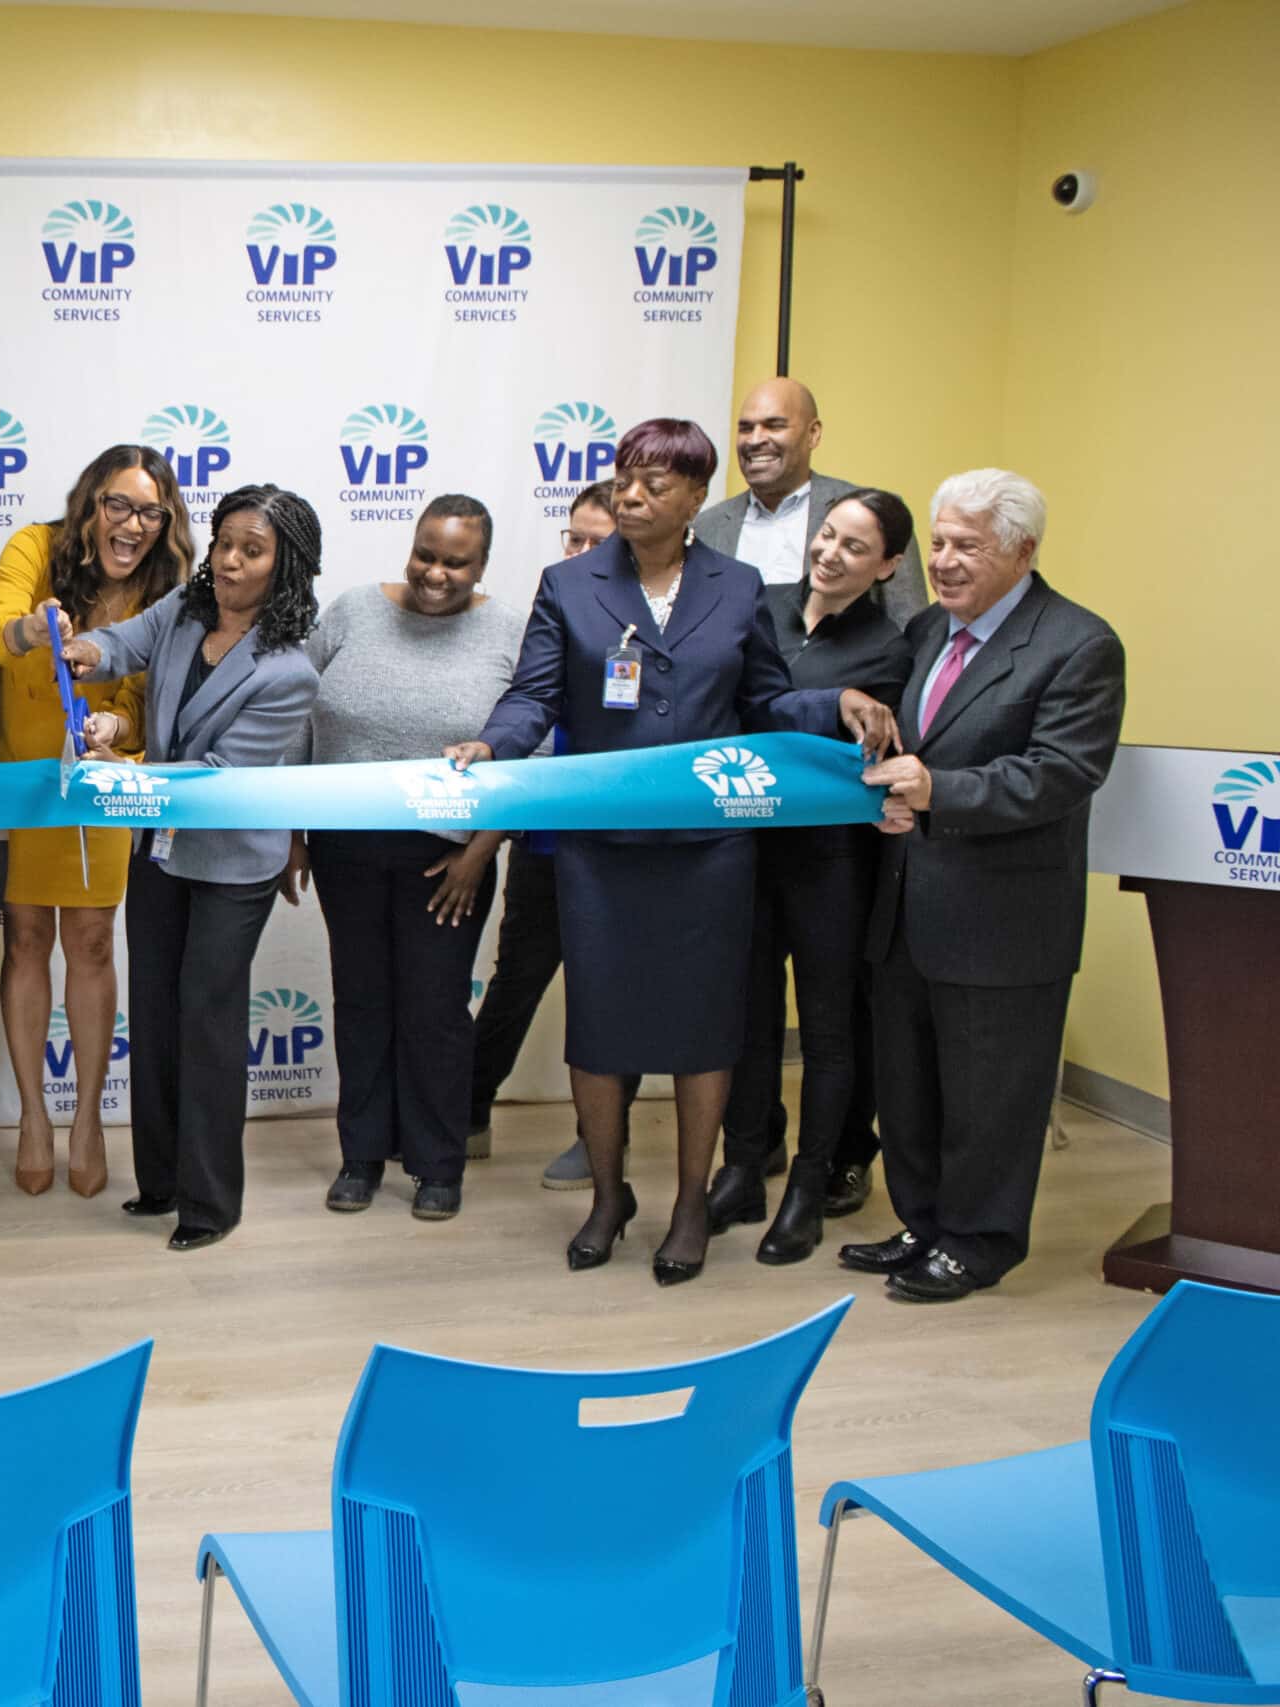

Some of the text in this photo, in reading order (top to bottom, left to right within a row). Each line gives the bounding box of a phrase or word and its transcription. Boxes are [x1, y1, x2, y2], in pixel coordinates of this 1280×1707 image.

[41, 288, 132, 301] COMMUNITY
[246, 290, 333, 302] COMMUNITY
[445, 289, 528, 302] COMMUNITY
[633, 290, 713, 303] COMMUNITY
[53, 308, 120, 321] SERVICES
[257, 309, 321, 322] SERVICES
[454, 309, 517, 322] SERVICES
[643, 310, 702, 322] SERVICES
[339, 489, 425, 502] COMMUNITY
[350, 509, 414, 521] SERVICES
[93, 795, 171, 807] COMMUNITY
[713, 797, 782, 808] COMMUNITY
[103, 806, 161, 817] SERVICES
[724, 807, 774, 818] SERVICES
[1228, 867, 1280, 883] SERVI
[248, 1067, 322, 1082] OMMUNITY
[43, 1079, 129, 1095] COMITY
[251, 1087, 312, 1101] SERVICES
